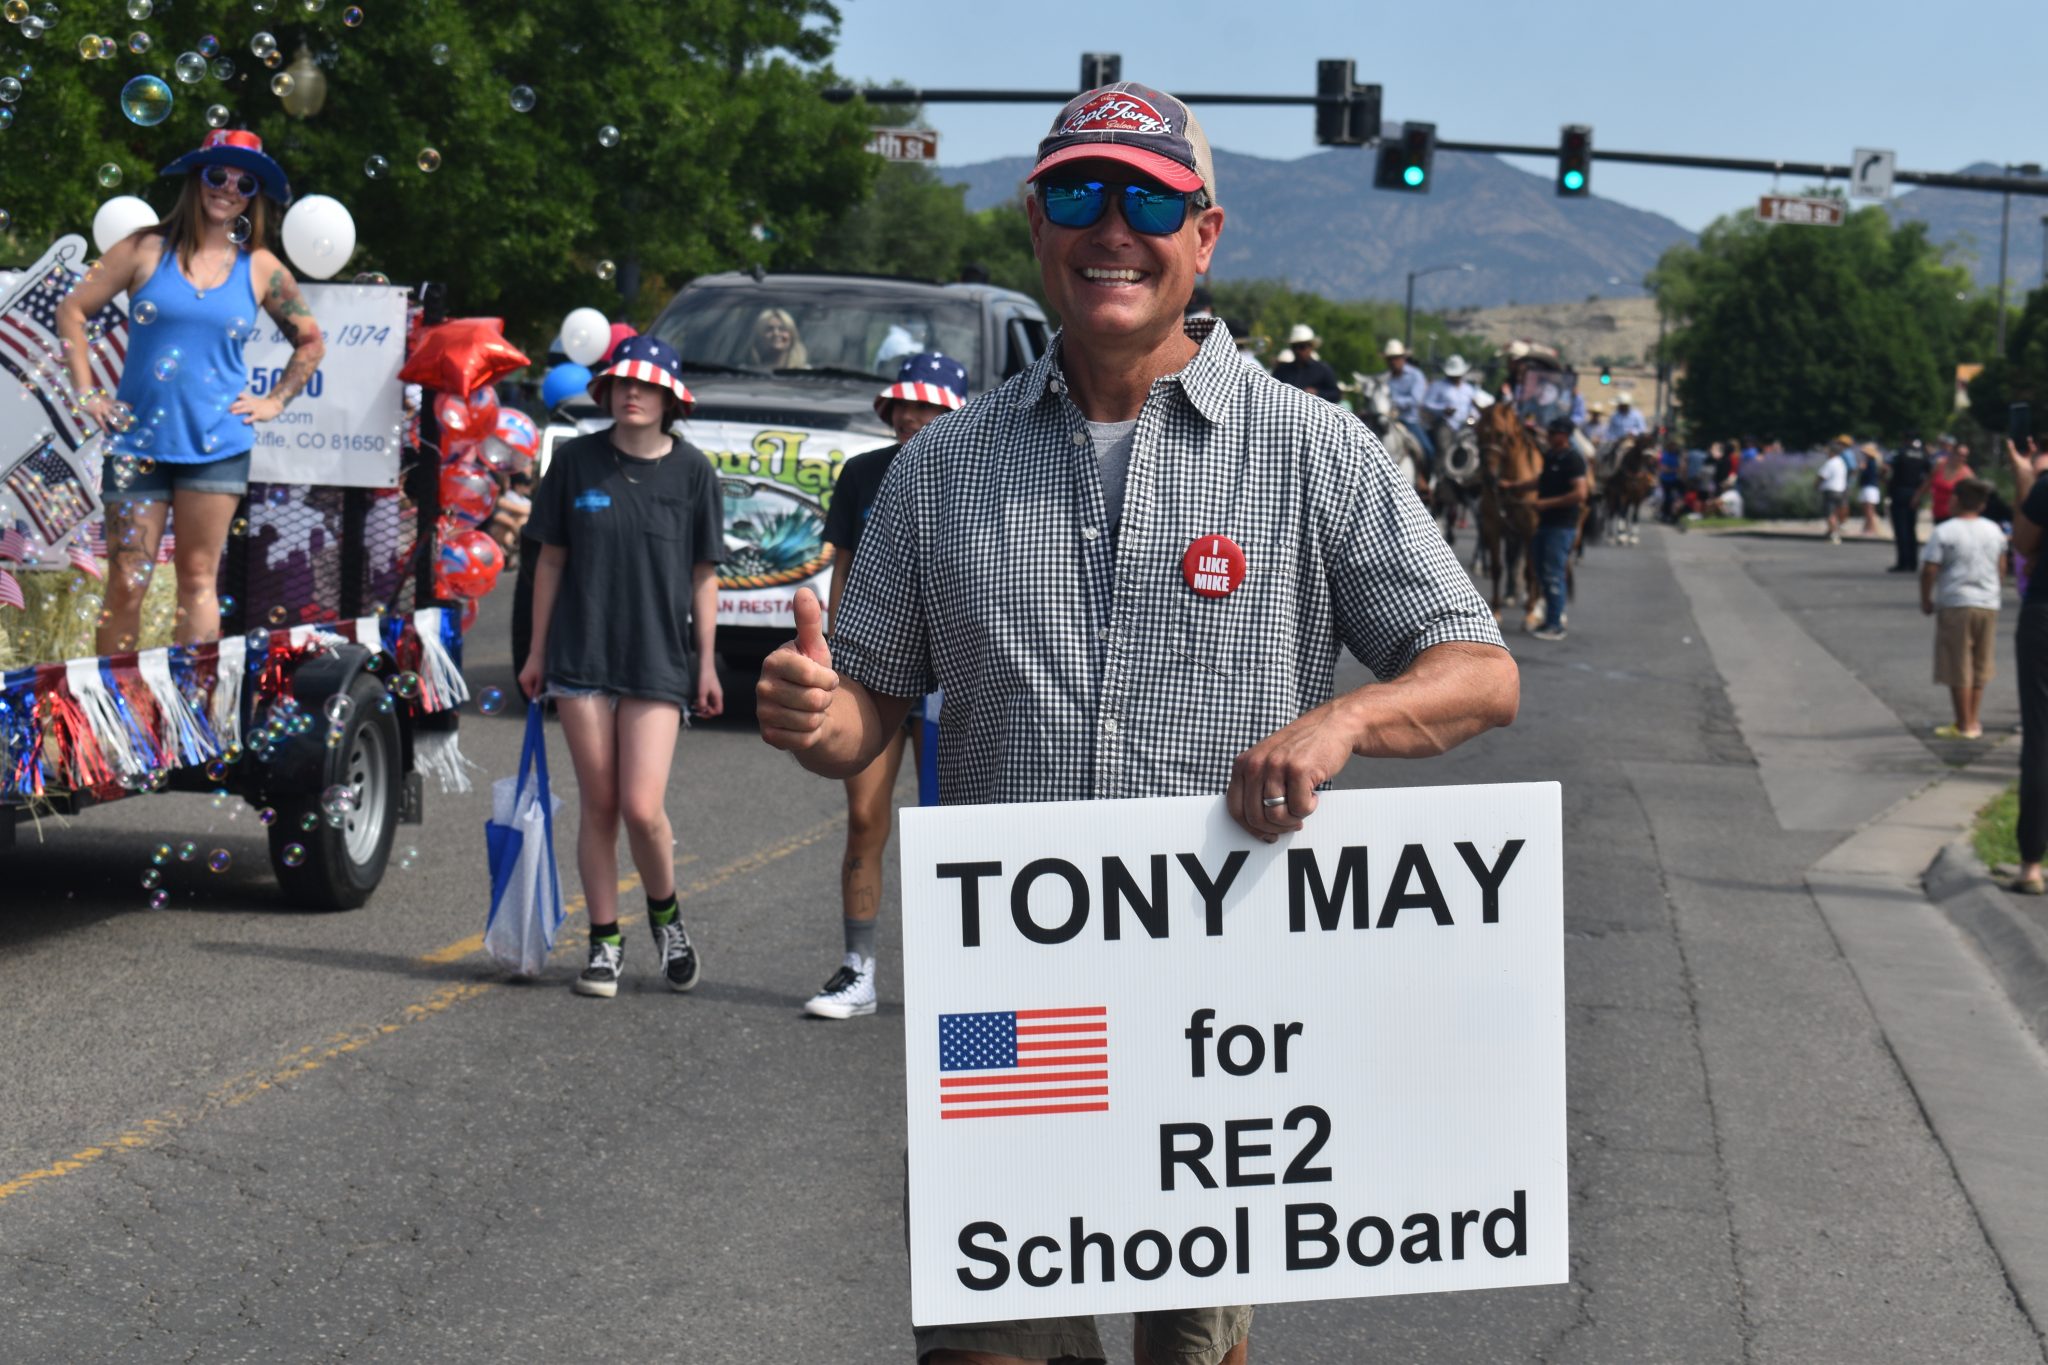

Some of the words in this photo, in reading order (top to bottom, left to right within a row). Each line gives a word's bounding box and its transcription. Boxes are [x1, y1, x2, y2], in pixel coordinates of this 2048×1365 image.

[337, 324, 391, 346] 1974
[296, 432, 326, 449] CO
[331, 434, 385, 452] 81650
[1212, 539, 1219, 555] I
[1199, 556, 1229, 574] LIKE
[1194, 573, 1230, 592] MIKE
[937, 851, 1250, 947] TONY
[1288, 840, 1525, 932] MAY
[1185, 1009, 1303, 1077] for
[1160, 1106, 1331, 1190] RE2
[957, 1207, 1249, 1290] School
[1286, 1190, 1526, 1270] Board
